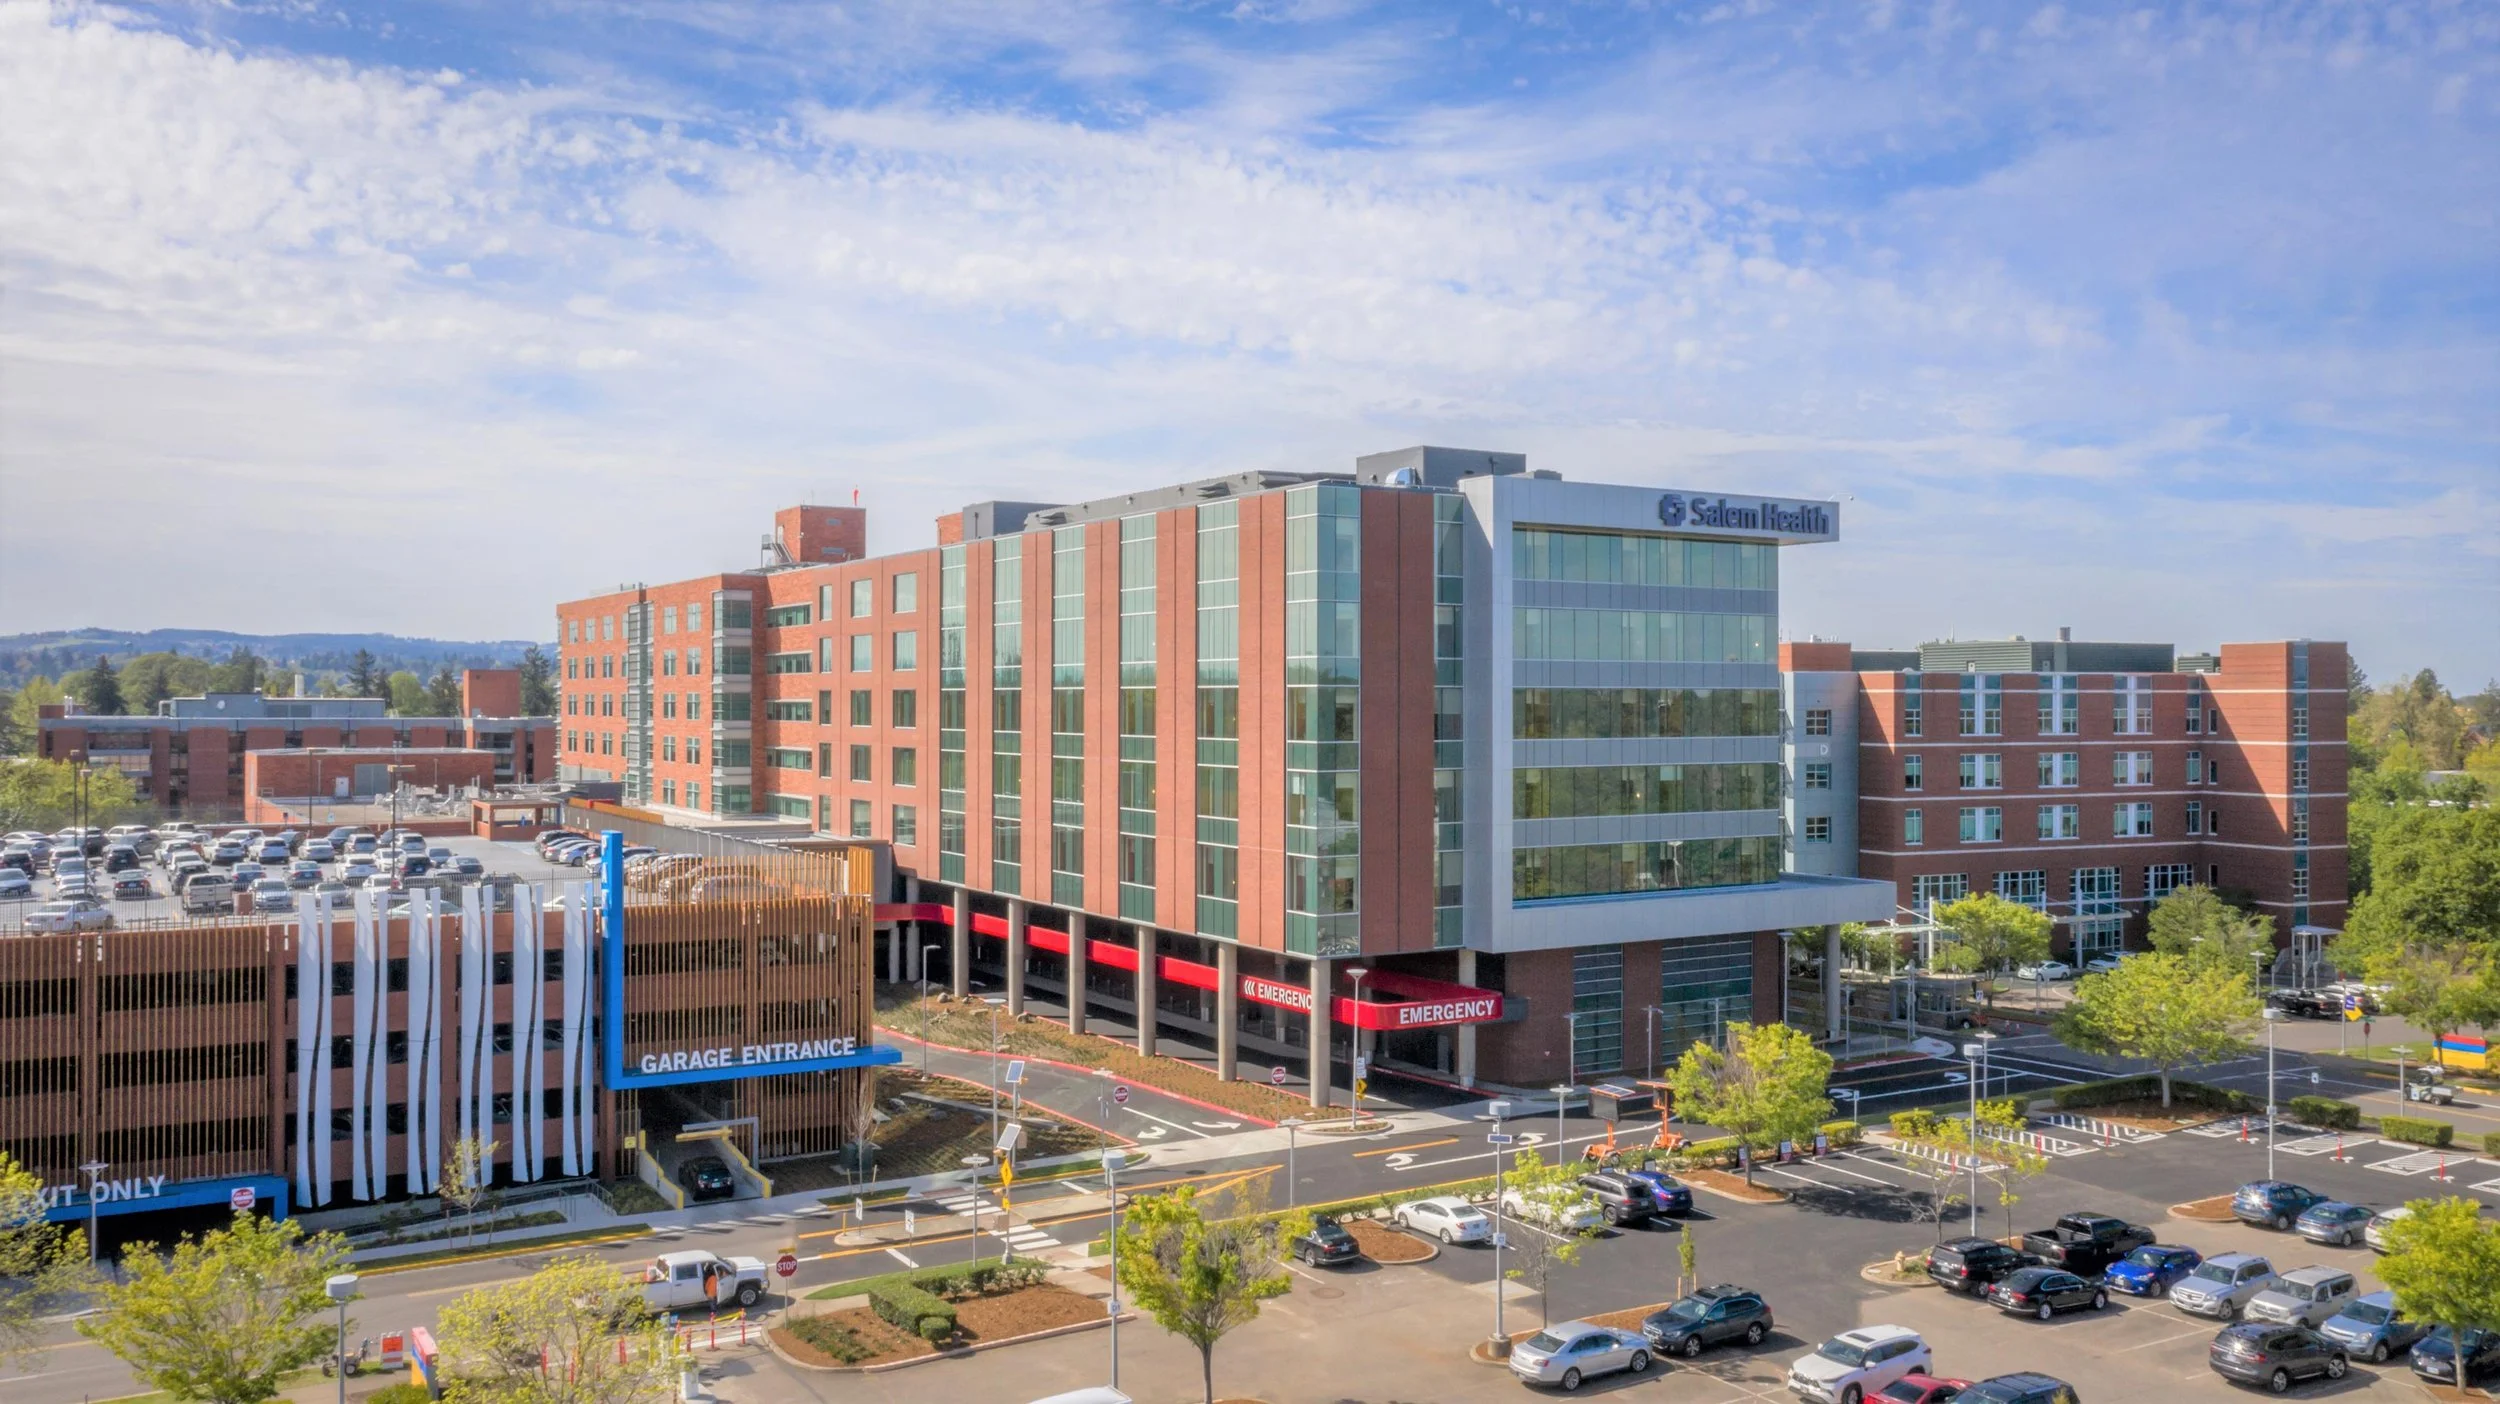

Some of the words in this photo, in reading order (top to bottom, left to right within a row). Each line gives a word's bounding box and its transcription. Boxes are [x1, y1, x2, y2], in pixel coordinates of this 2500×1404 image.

[1691, 497, 1759, 529] Salem
[1761, 502, 1829, 534] Health
[1820, 744, 1829, 756] D
[1258, 983, 1312, 1010] EMERGENC
[1400, 1000, 1494, 1025] EMERGENCY
[641, 1048, 732, 1074] GARAGE
[742, 1037, 856, 1065] ENTRANCE
[90, 1174, 165, 1204] ONLY
[778, 1260, 797, 1272] STOP
